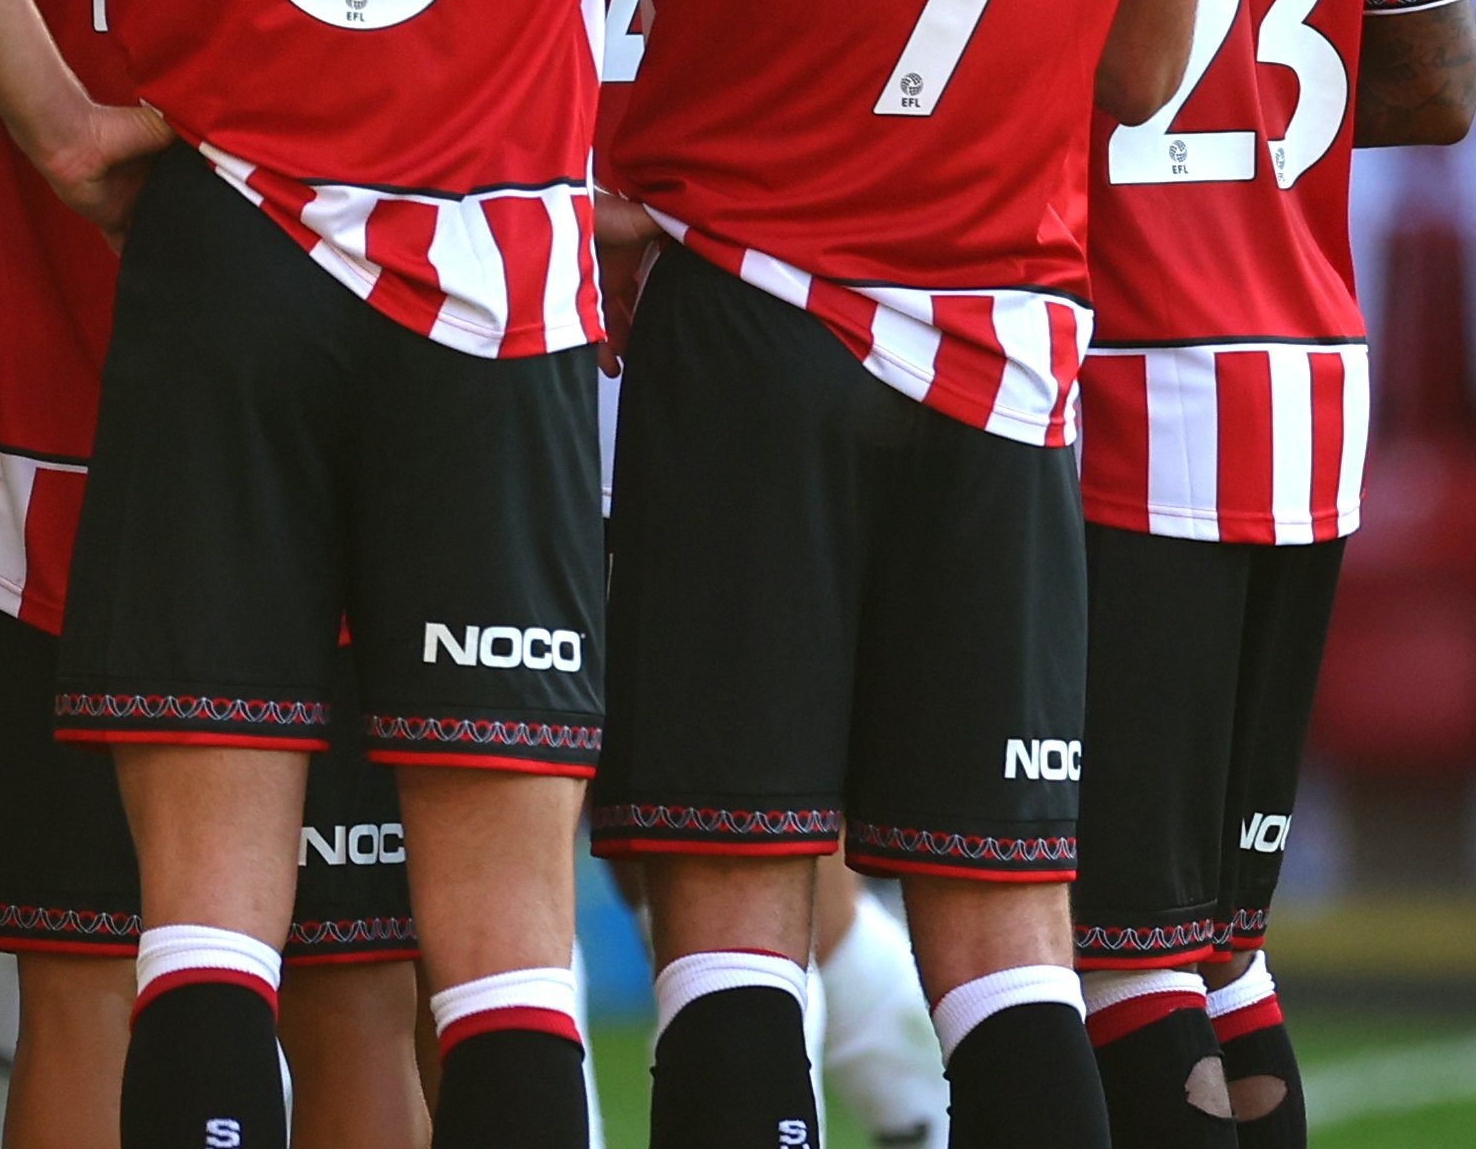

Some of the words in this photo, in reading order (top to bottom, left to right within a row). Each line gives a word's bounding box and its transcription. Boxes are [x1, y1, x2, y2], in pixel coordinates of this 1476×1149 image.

[346, 11, 365, 22] EFL
[901, 97, 921, 108] EFL
[1172, 164, 1189, 175] EFL
[424, 622, 582, 673] NOCO
[297, 822, 406, 867] NOC
[1239, 812, 1292, 853] NO
[205, 1118, 240, 1149] S
